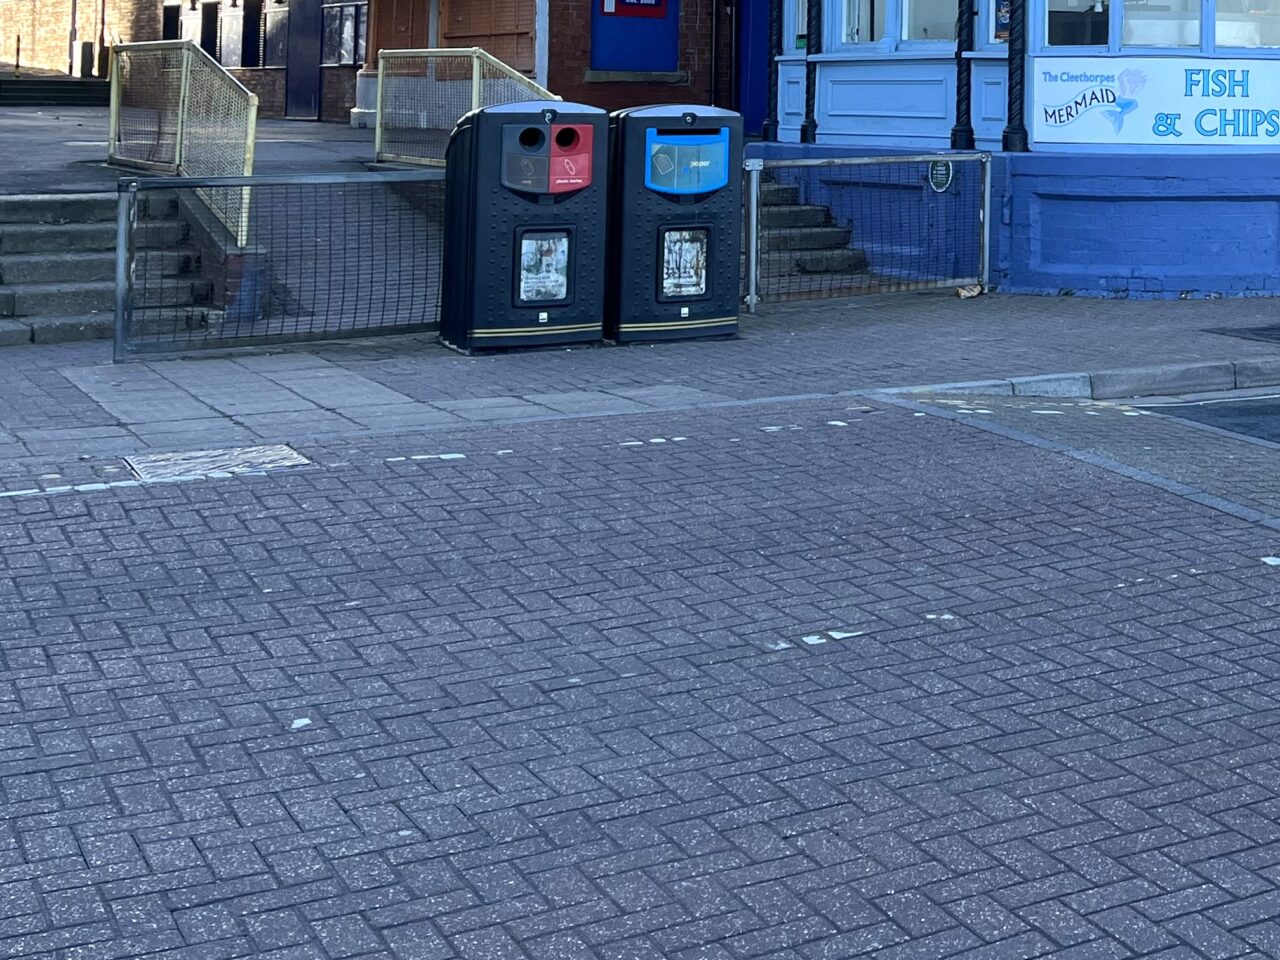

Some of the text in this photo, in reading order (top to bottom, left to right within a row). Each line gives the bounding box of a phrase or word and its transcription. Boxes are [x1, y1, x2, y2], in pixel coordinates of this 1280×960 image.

[1042, 71, 1115, 85] The Cleethorpes
[1184, 68, 1249, 98] FISH
[1044, 87, 1117, 124] MERMAID
[1152, 109, 1280, 137] & CHIPS
